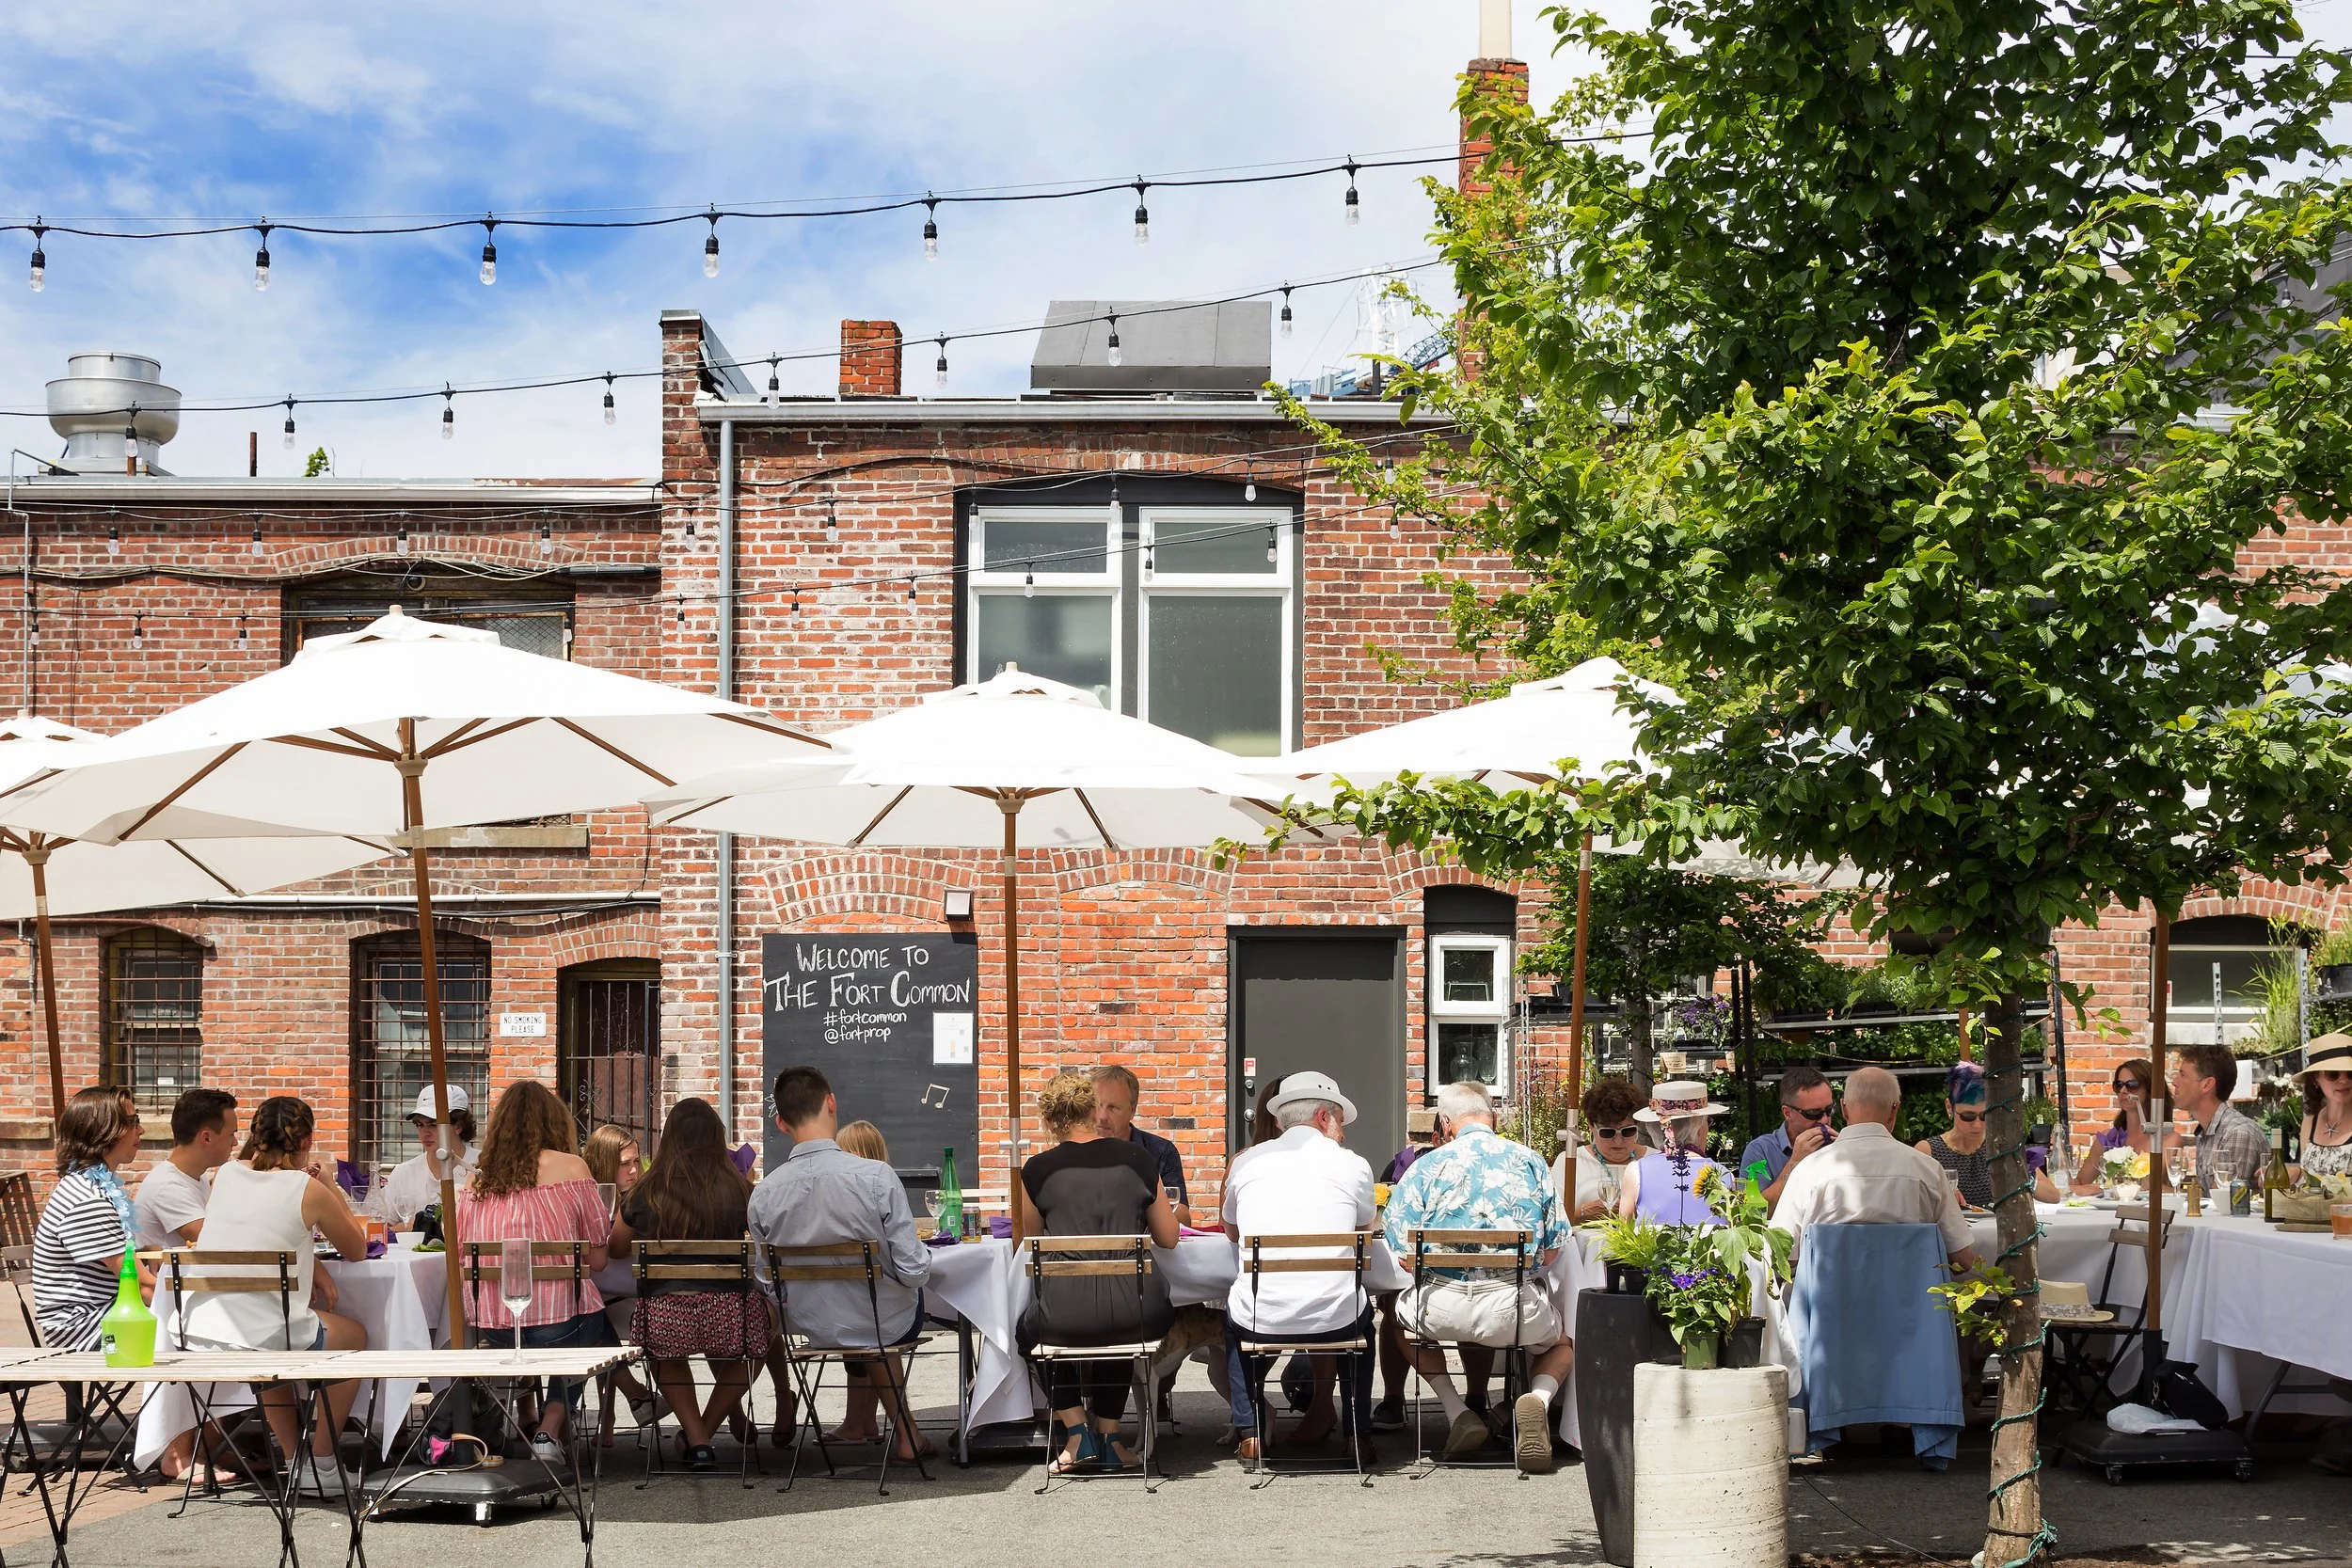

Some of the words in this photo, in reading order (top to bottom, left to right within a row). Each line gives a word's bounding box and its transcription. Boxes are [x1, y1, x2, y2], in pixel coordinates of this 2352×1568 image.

[795, 942, 891, 972] WELCOME
[901, 944, 930, 967] TO
[763, 971, 818, 1012] THE
[829, 971, 886, 1007] FORT
[890, 970, 971, 1007] COMMON
[822, 1008, 907, 1027] #fortcommon
[824, 1025, 892, 1044] @fortprop
